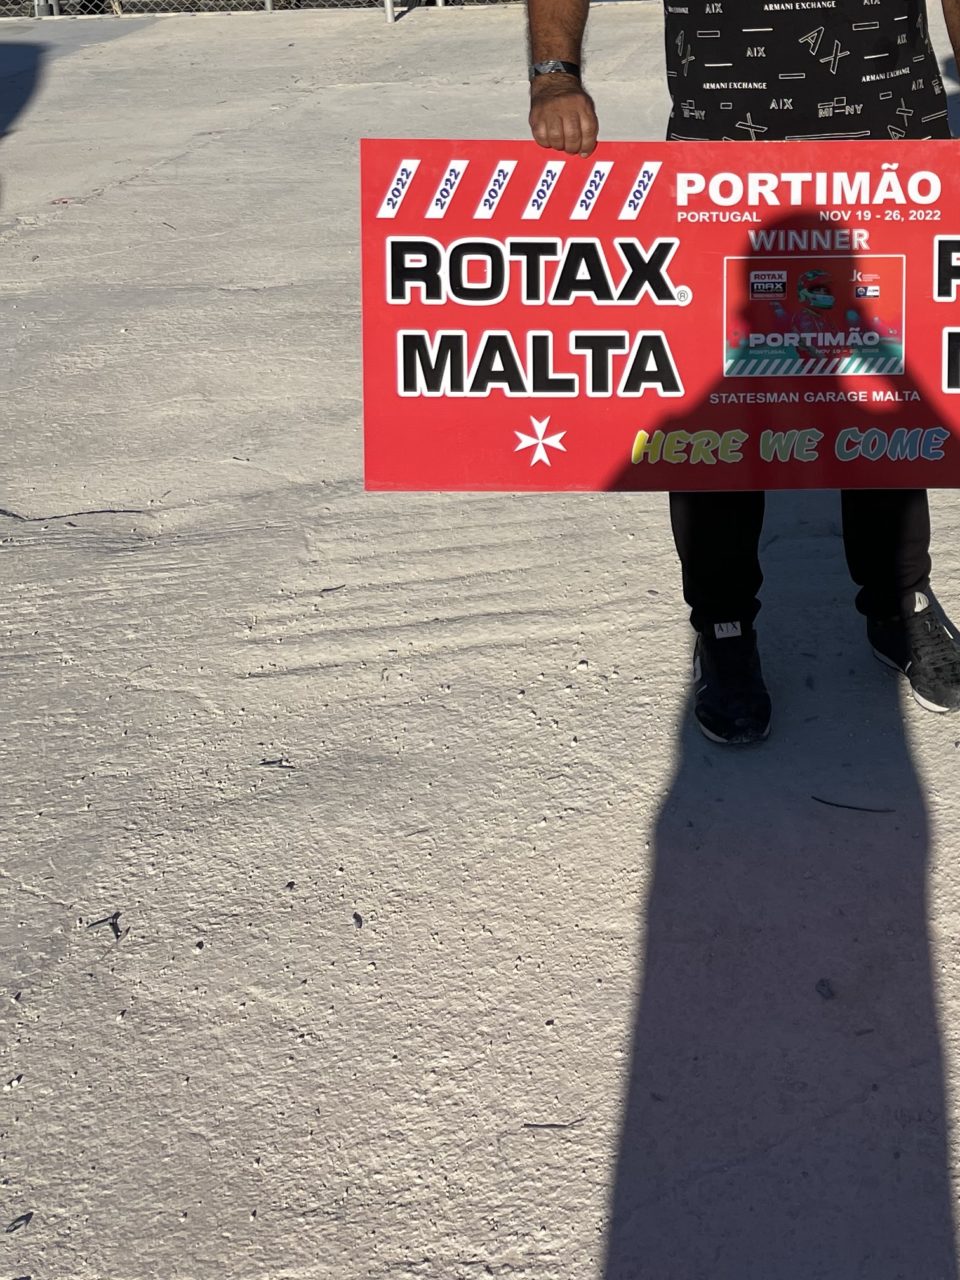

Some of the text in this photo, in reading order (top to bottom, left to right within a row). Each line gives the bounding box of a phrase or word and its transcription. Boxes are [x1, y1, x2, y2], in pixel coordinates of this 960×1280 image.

[763, 1, 837, 11] ARMANI EXCHANGE
[703, 82, 768, 90] ARMANI EXCHANGE
[861, 72, 886, 83] ARMANI
[387, 167, 412, 209] 2022
[435, 168, 460, 210] 2022
[483, 168, 509, 210] 2022
[531, 169, 557, 211] 2022
[580, 169, 605, 211] 2022
[628, 169, 654, 212] 2022
[676, 163, 942, 207] PORTIMÃO
[677, 211, 762, 223] PORTUGAL
[819, 211, 851, 222] NOV
[855, 210, 872, 221] 19
[884, 210, 905, 223] 26,
[908, 210, 942, 221] 2022
[748, 228, 870, 252] WINNER
[388, 237, 682, 305] ROTAX
[753, 273, 784, 281] ROTAX
[750, 327, 881, 347] PORTIMÃO
[398, 331, 685, 397] MALTA
[709, 391, 921, 404] STATESMAN GARAGE MALTA
[631, 429, 748, 464] HERE
[760, 428, 824, 462] WE
[835, 426, 949, 461] COME
